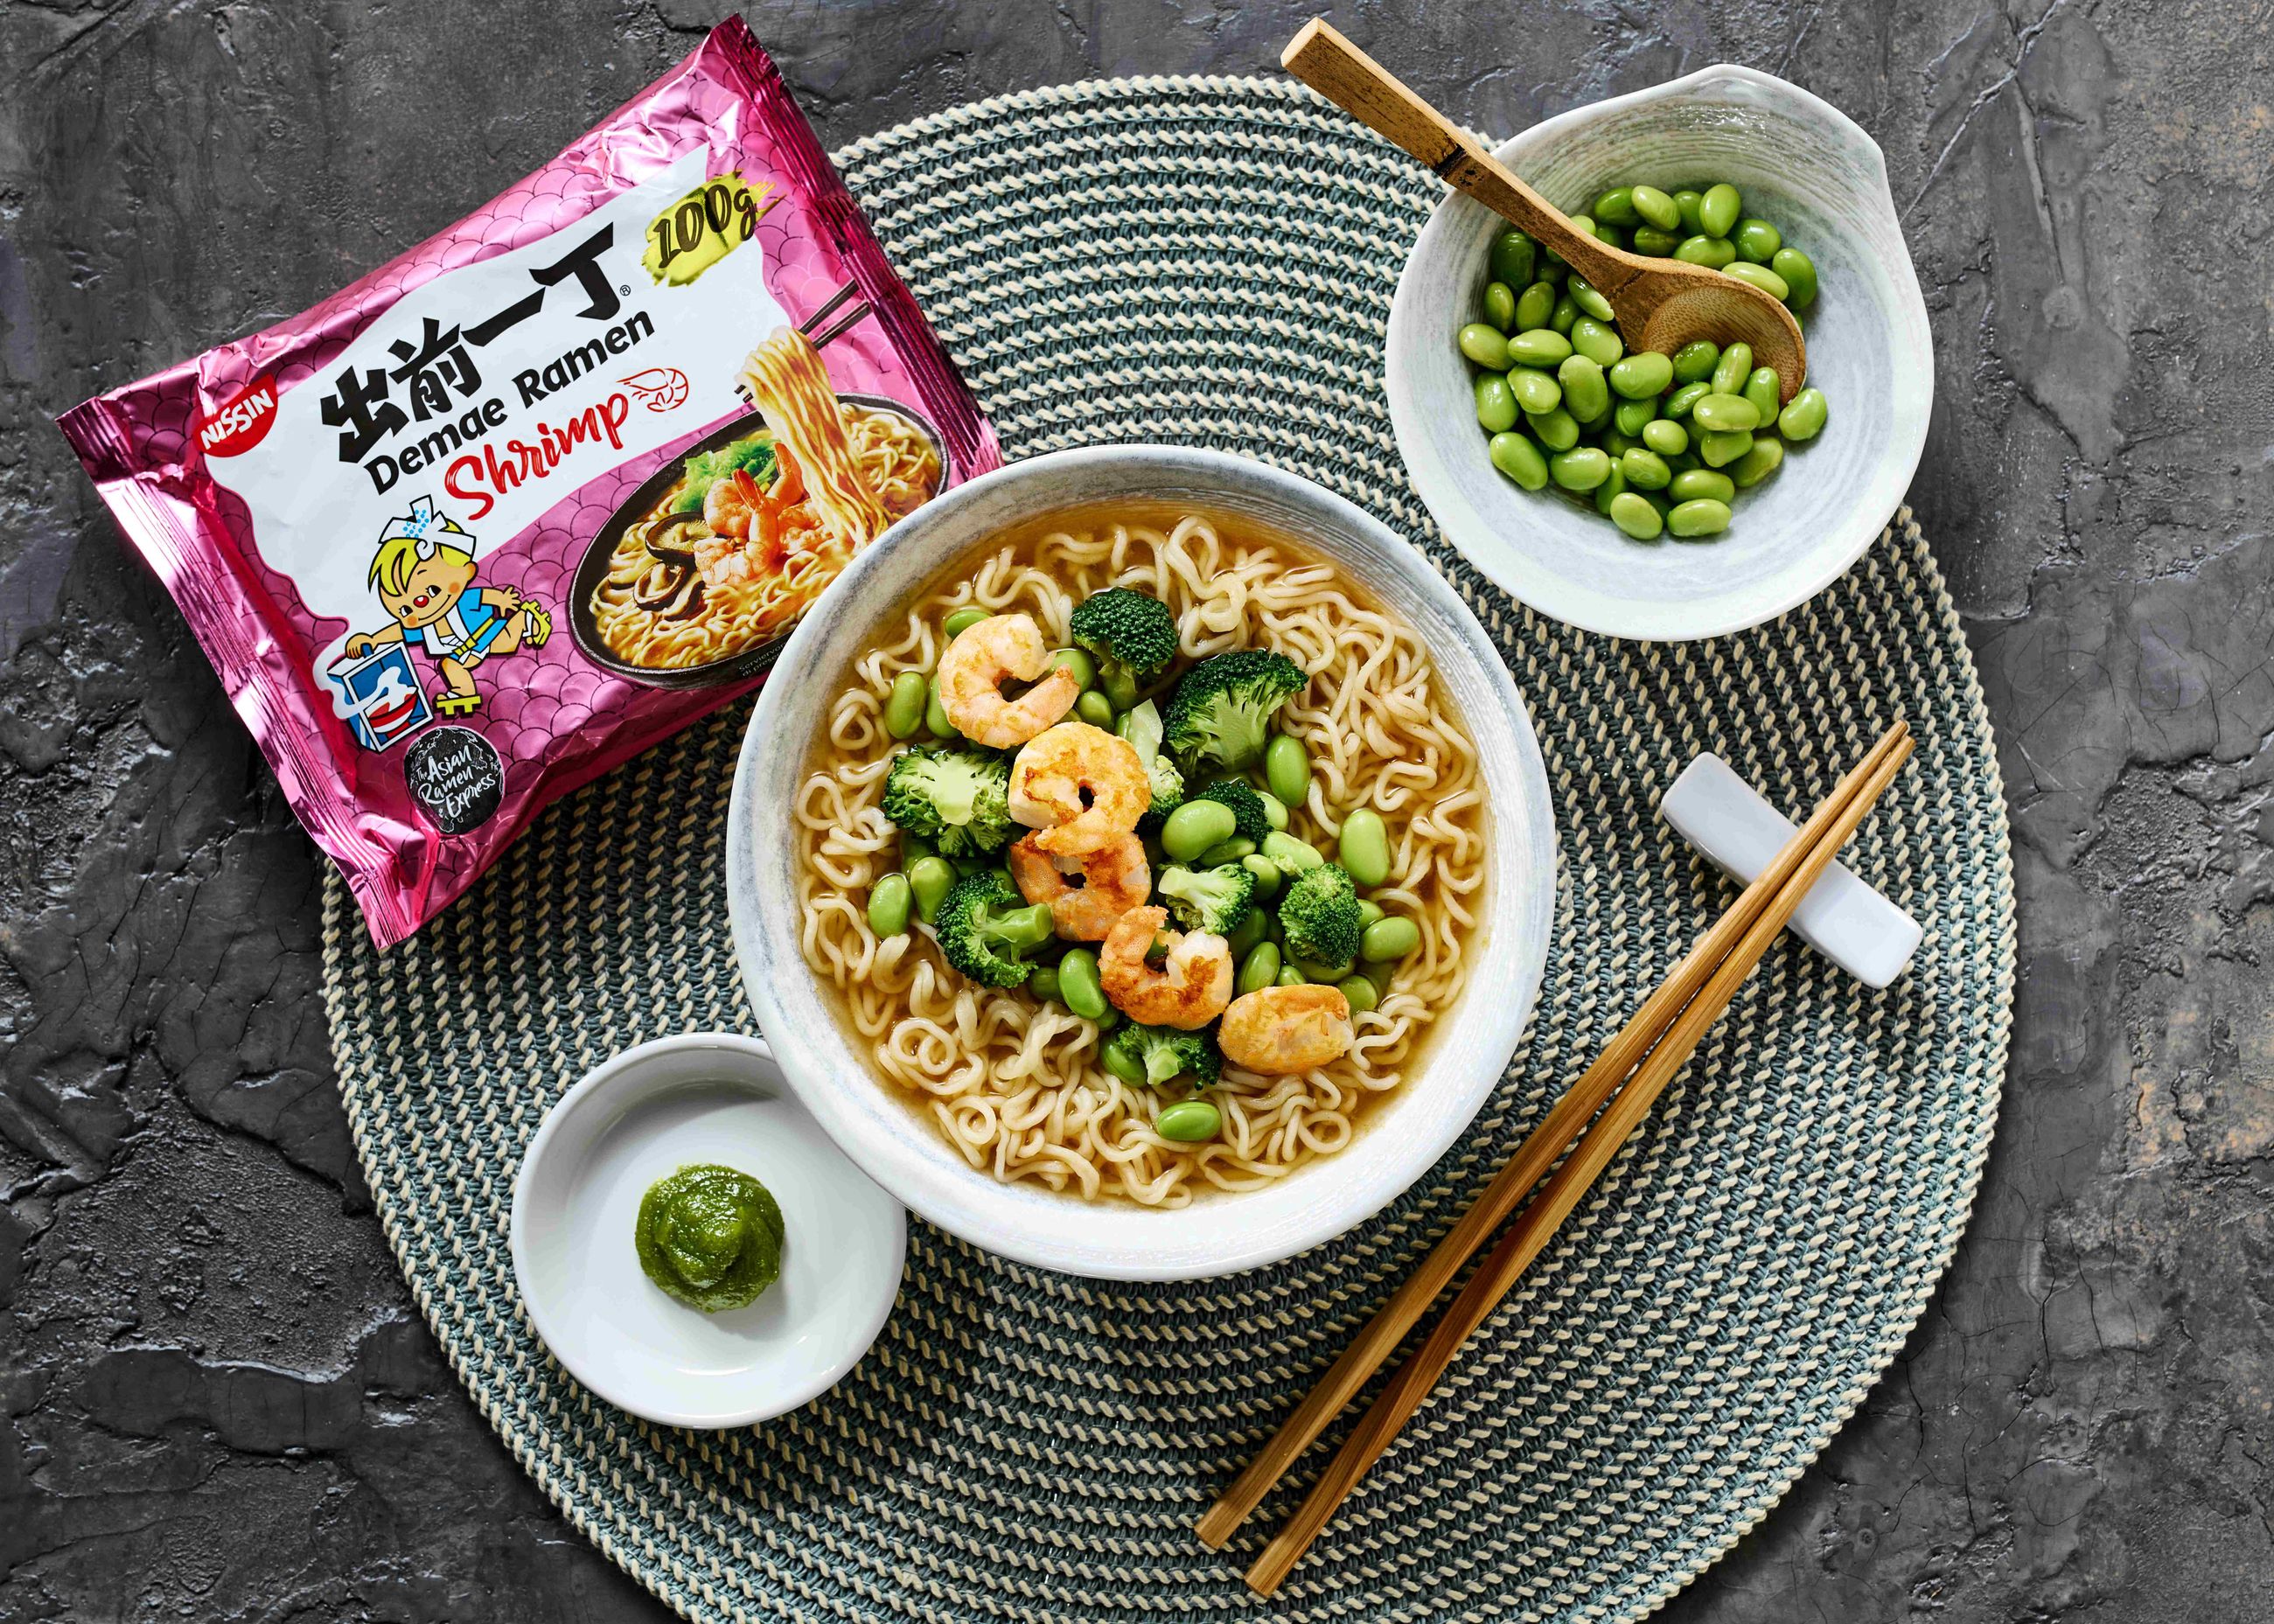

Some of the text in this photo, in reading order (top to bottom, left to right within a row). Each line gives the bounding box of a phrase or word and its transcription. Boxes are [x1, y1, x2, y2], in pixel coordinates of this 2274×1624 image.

[652, 184, 758, 268] 100g
[319, 221, 621, 464] 出前一丁
[200, 388, 275, 450] NISSIN
[363, 310, 655, 496] Demae Ramen
[443, 392, 630, 521] Shrimp
[416, 744, 472, 784] The Asian
[417, 765, 474, 806] Ramen
[445, 772, 496, 819] Express
